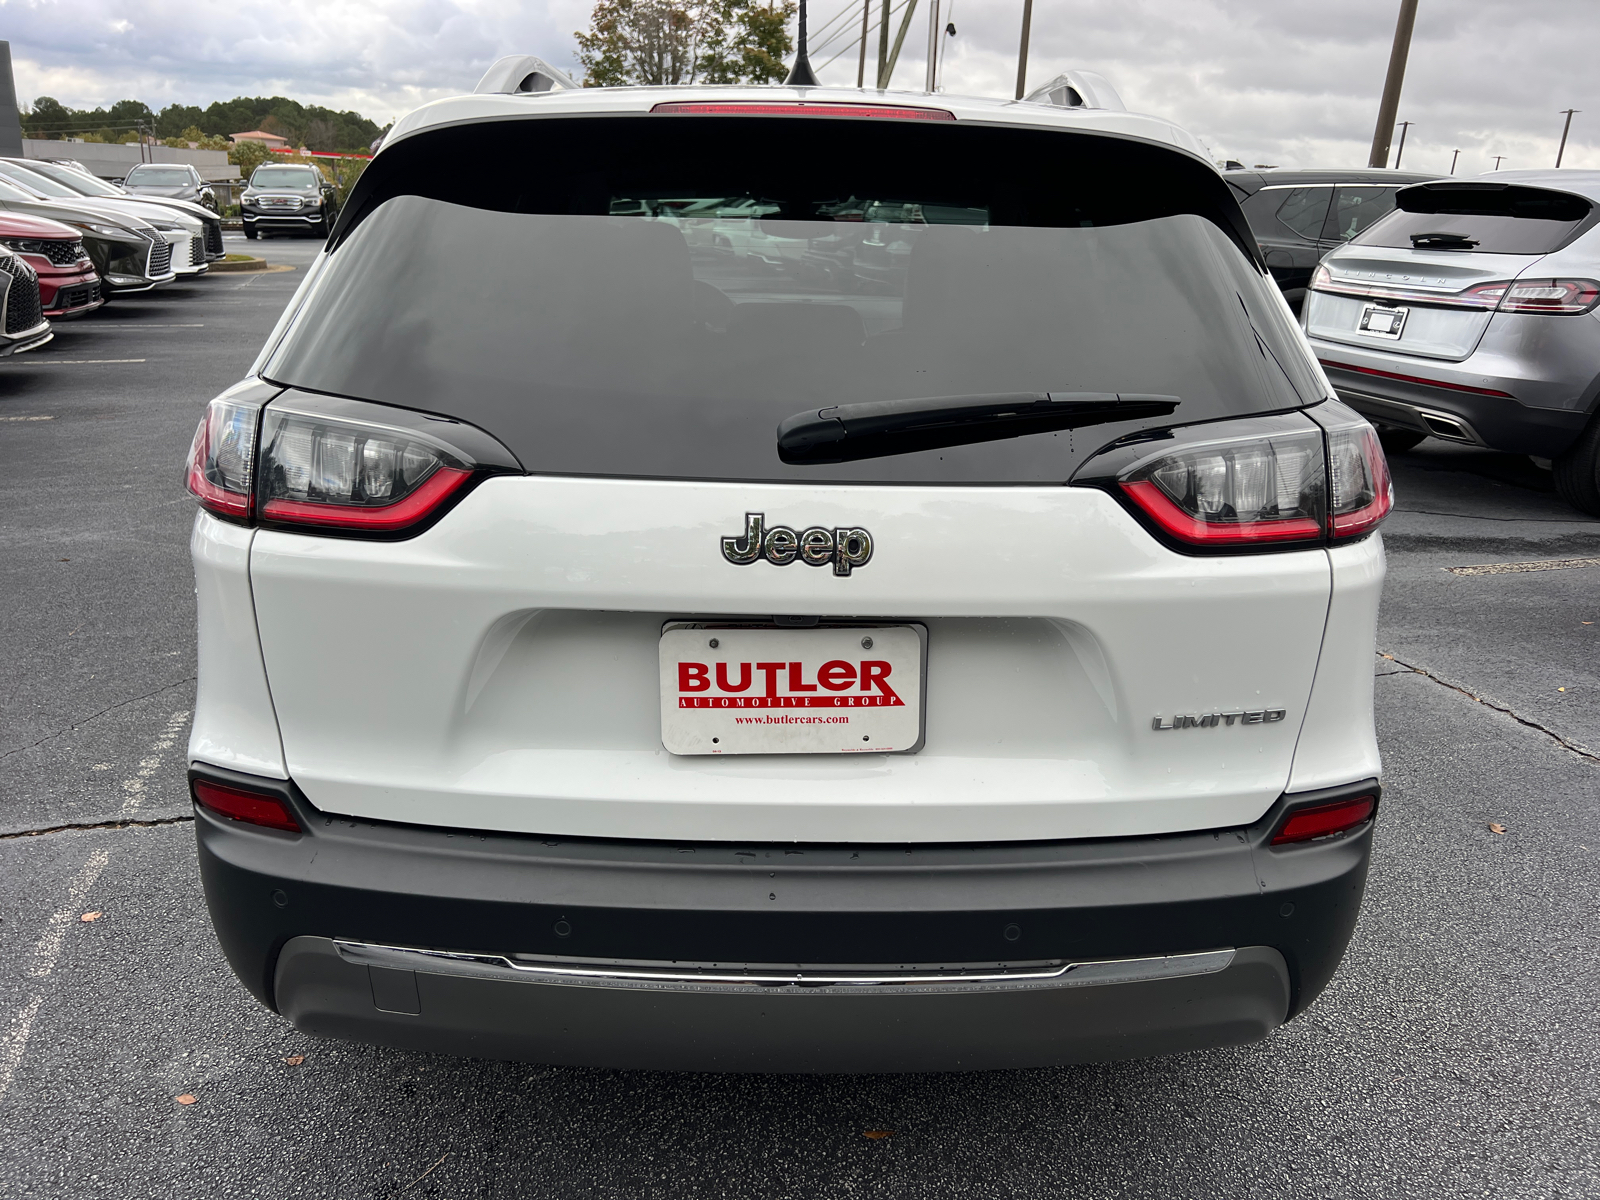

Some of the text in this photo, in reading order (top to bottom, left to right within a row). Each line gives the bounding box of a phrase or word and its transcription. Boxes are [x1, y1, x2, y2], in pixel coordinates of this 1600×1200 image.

[1344, 269, 1446, 284] LINCOLN
[720, 512, 874, 577] Jeep
[679, 695, 898, 708] AUTOMOTIVE GROUP
[735, 714, 849, 725] www.butlercars.com
[1152, 708, 1286, 730] LIMITED
